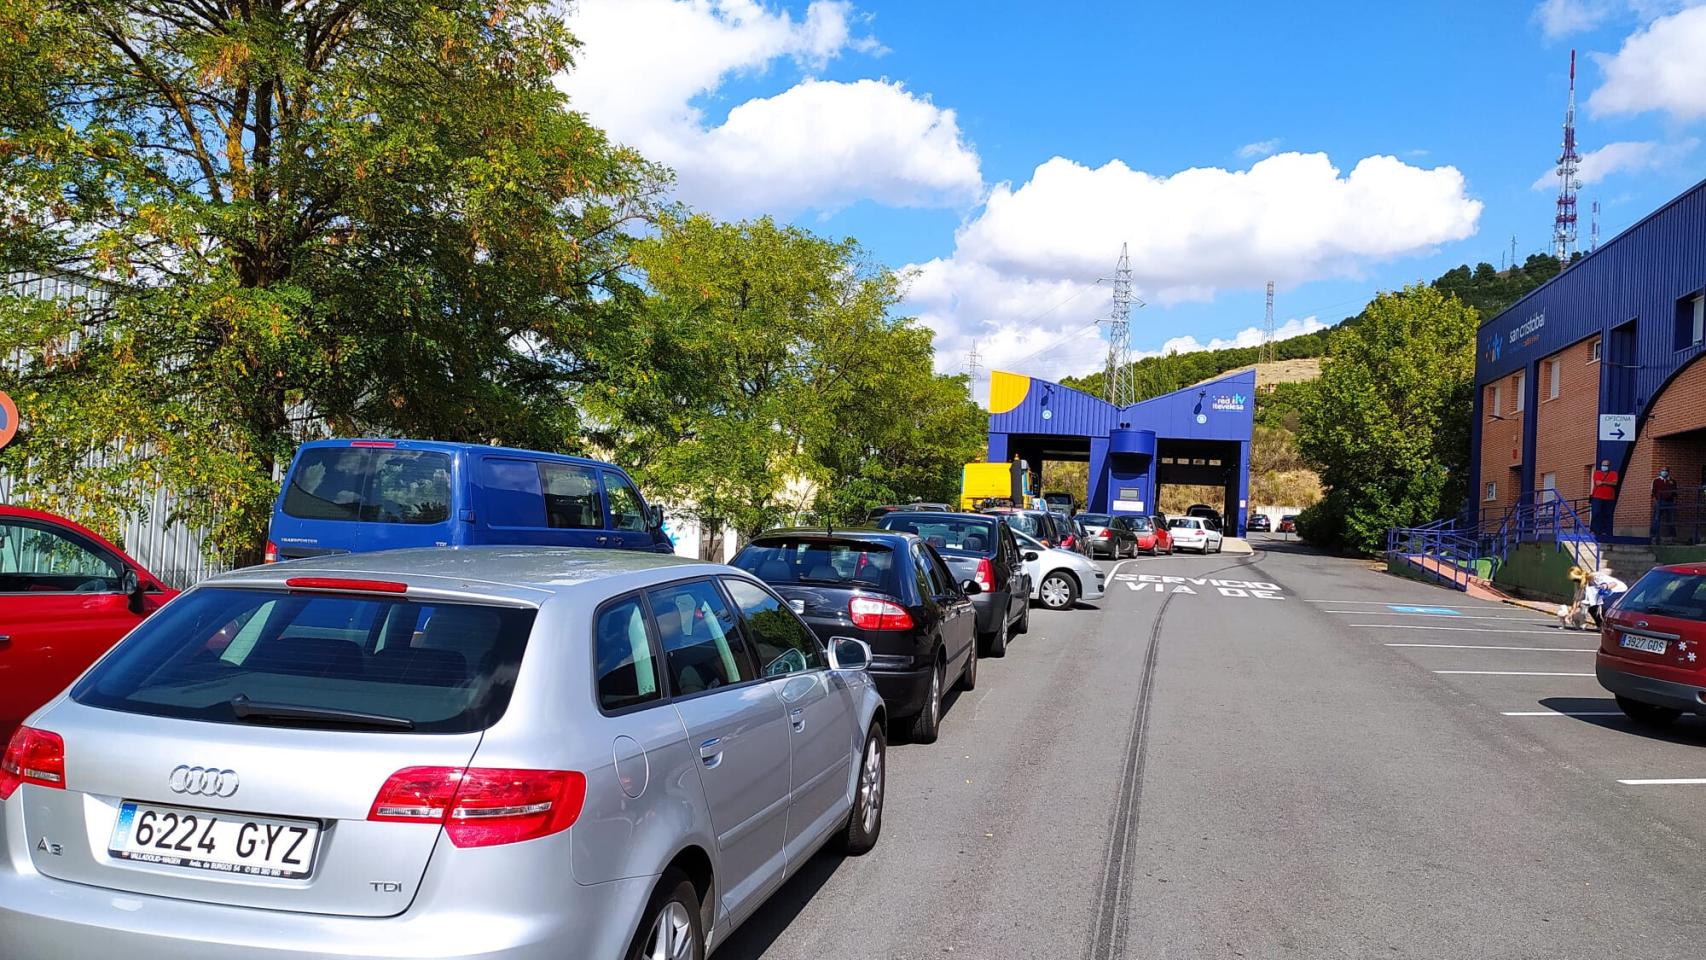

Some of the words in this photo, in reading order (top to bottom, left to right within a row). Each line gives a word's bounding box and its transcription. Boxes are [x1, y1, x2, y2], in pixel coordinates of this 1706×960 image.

[1114, 573, 1282, 591] SERVICIO
[1126, 582, 1198, 595] VIA
[1217, 587, 1286, 600] DE
[1625, 636, 1646, 648] 3927
[1647, 639, 1664, 652] GDS
[37, 836, 63, 856] A3
[135, 810, 218, 854] 6224
[236, 822, 308, 865] GYZ
[369, 881, 402, 892] TDI
